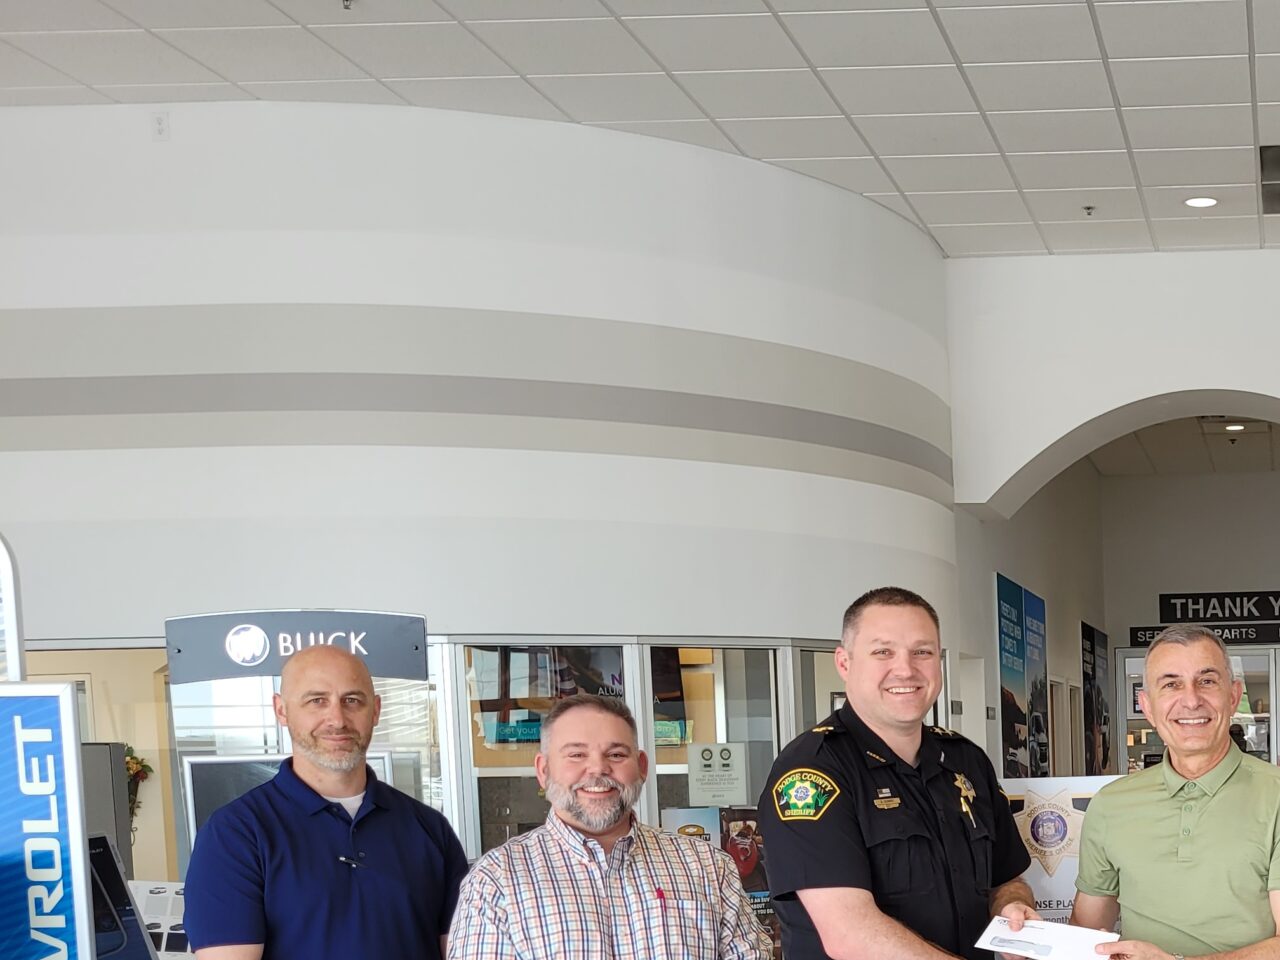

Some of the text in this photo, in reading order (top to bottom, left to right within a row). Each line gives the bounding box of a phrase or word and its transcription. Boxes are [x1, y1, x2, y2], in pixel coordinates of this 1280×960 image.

[1170, 597, 1261, 619] THANK
[1214, 628, 1257, 640] PARTS
[517, 727, 537, 736] your
[777, 773, 834, 793] DODGE COUNTY
[784, 809, 816, 817] SHERIFF
[1027, 803, 1047, 818] DODGE
[1047, 803, 1071, 818] COUNTY
[1035, 900, 1054, 909] NSE
